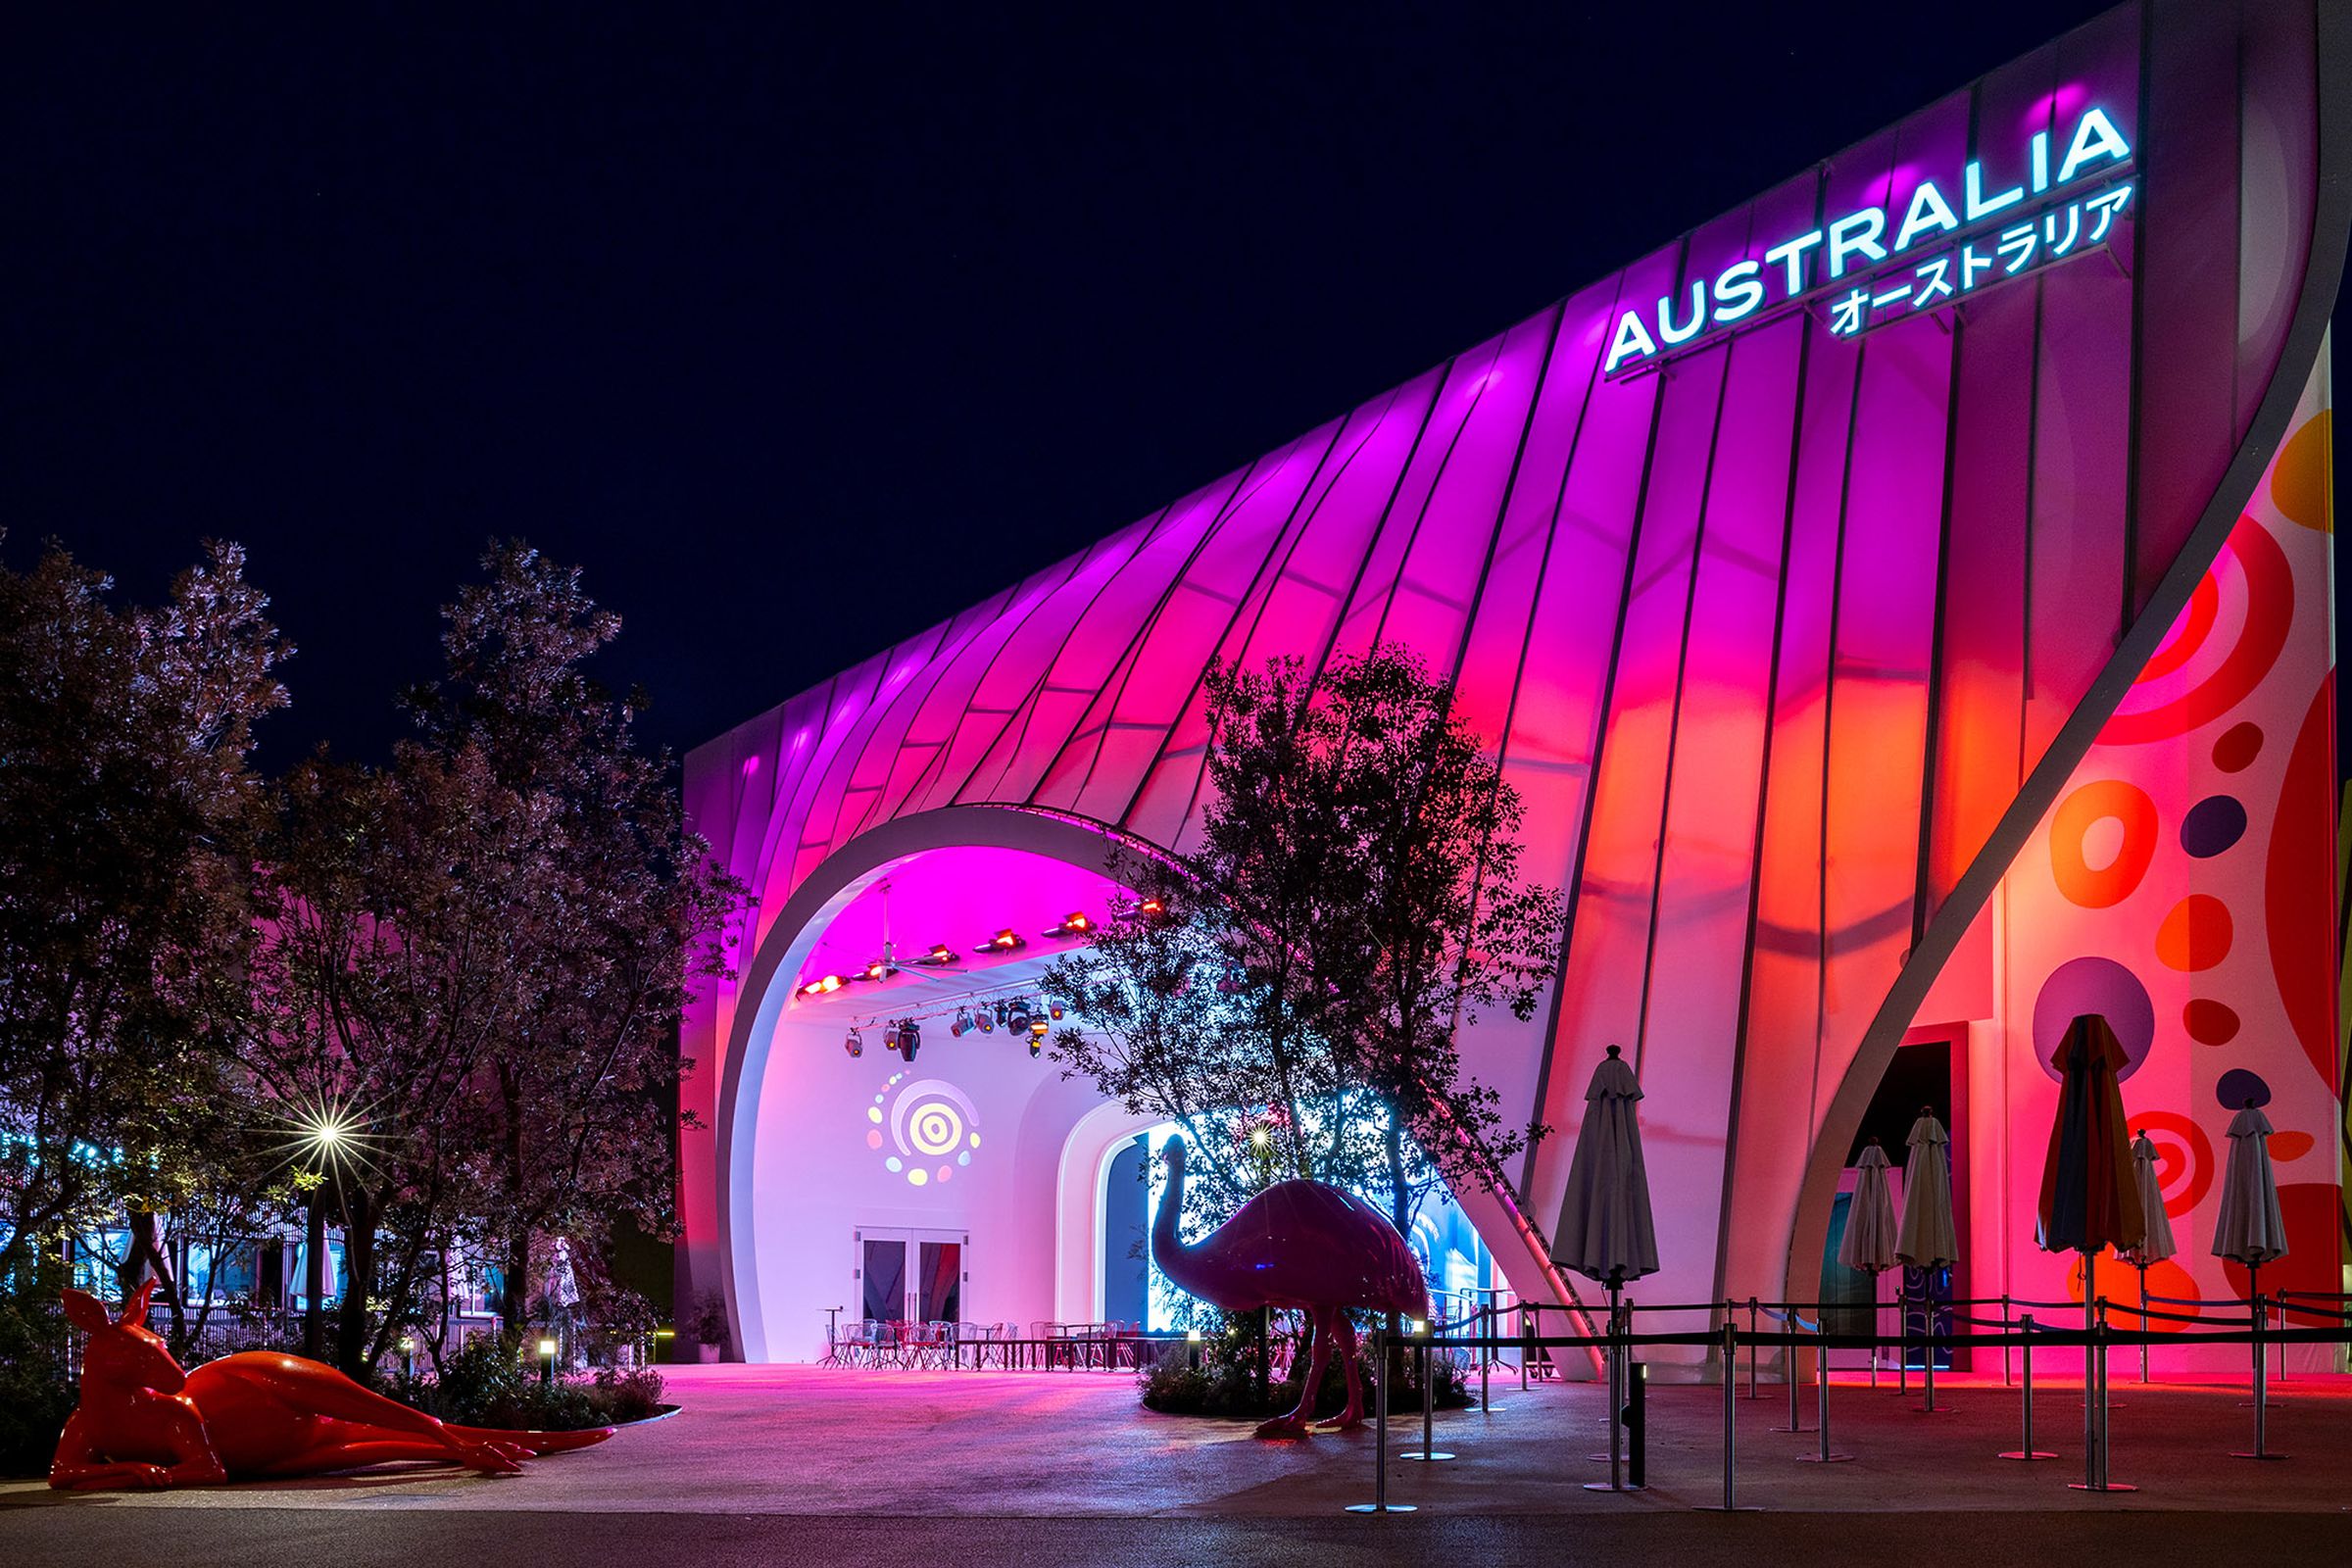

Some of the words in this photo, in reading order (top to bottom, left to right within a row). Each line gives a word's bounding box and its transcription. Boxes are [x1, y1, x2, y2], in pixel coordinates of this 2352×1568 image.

[1604, 107, 2131, 372] AUSTRALIA
[1831, 183, 2133, 336] オーストラリア
